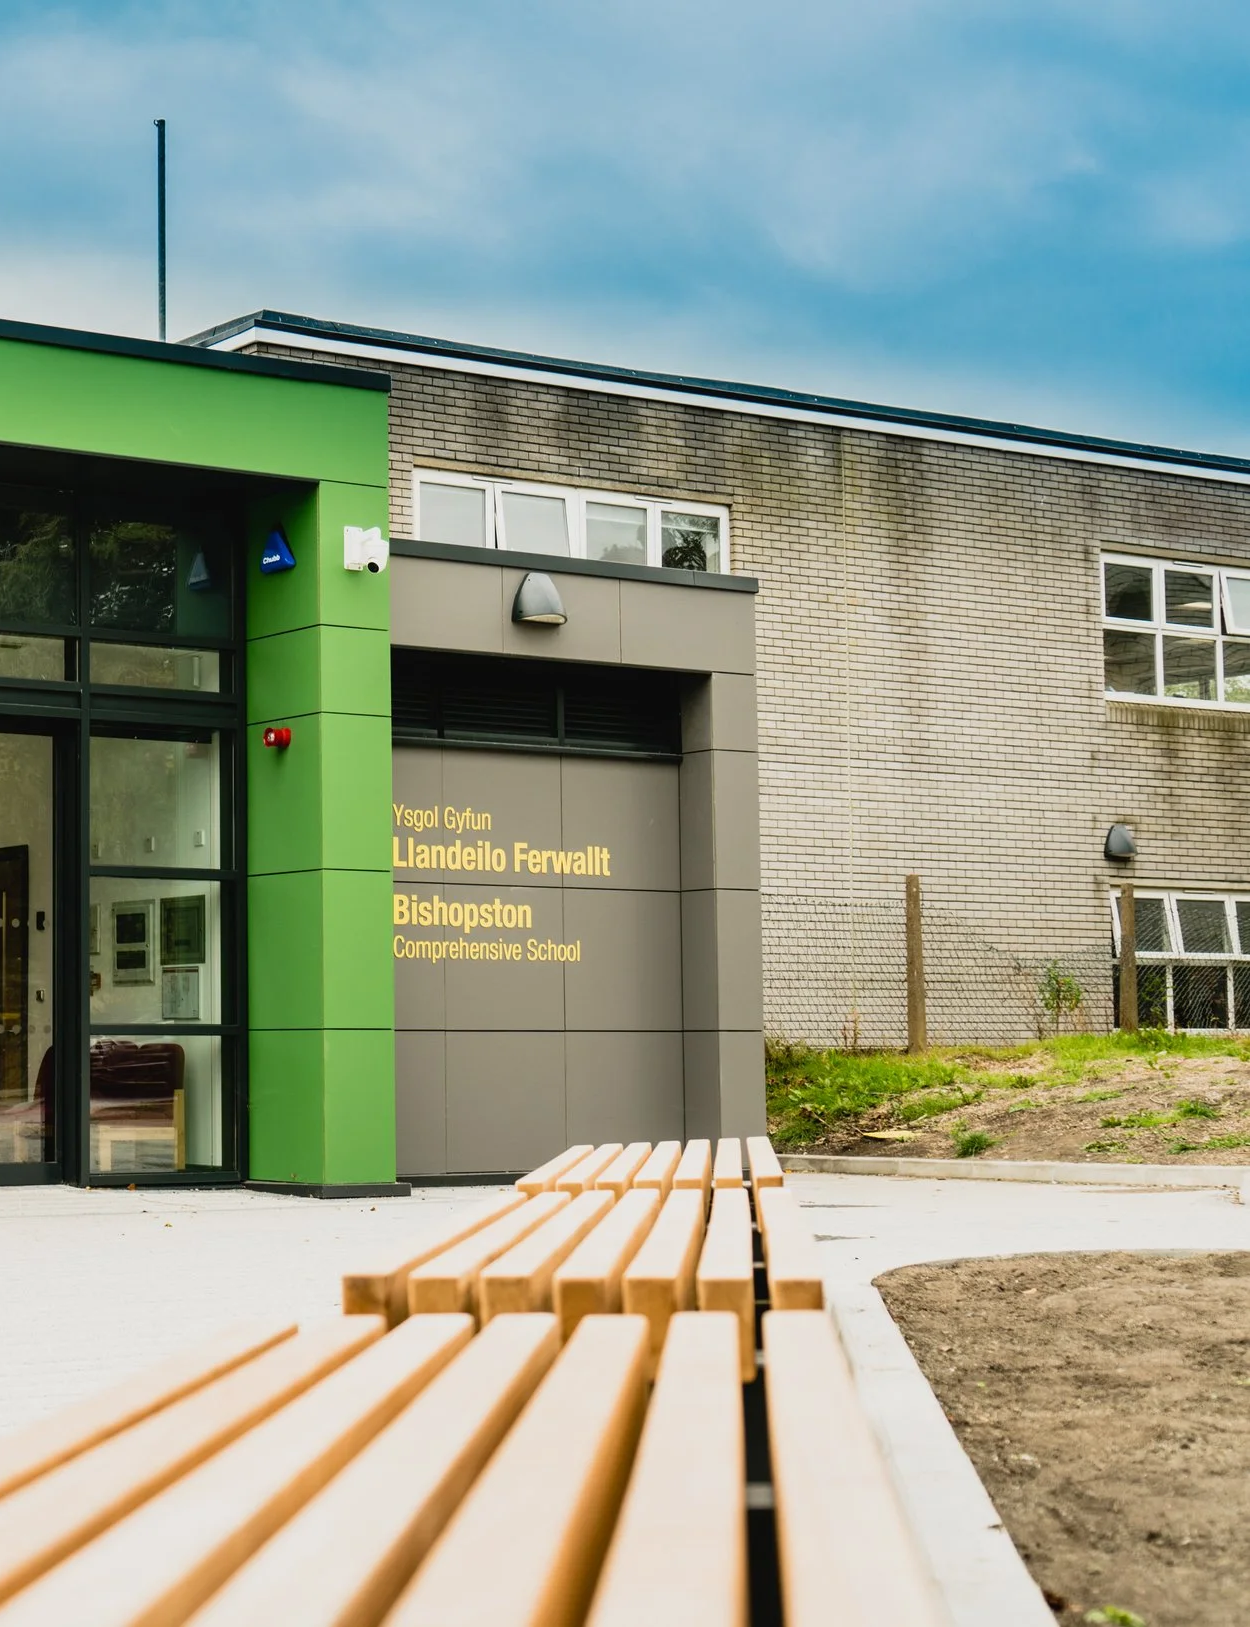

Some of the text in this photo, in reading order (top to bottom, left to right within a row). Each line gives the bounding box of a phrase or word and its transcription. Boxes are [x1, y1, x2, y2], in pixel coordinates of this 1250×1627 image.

[262, 553, 281, 565] Chubb
[392, 803, 491, 833] Ysgol Gyfun
[392, 836, 610, 876] Llandeilo Ferwallt
[393, 893, 532, 933] Bishopston
[393, 934, 580, 963] Comprehensive School
